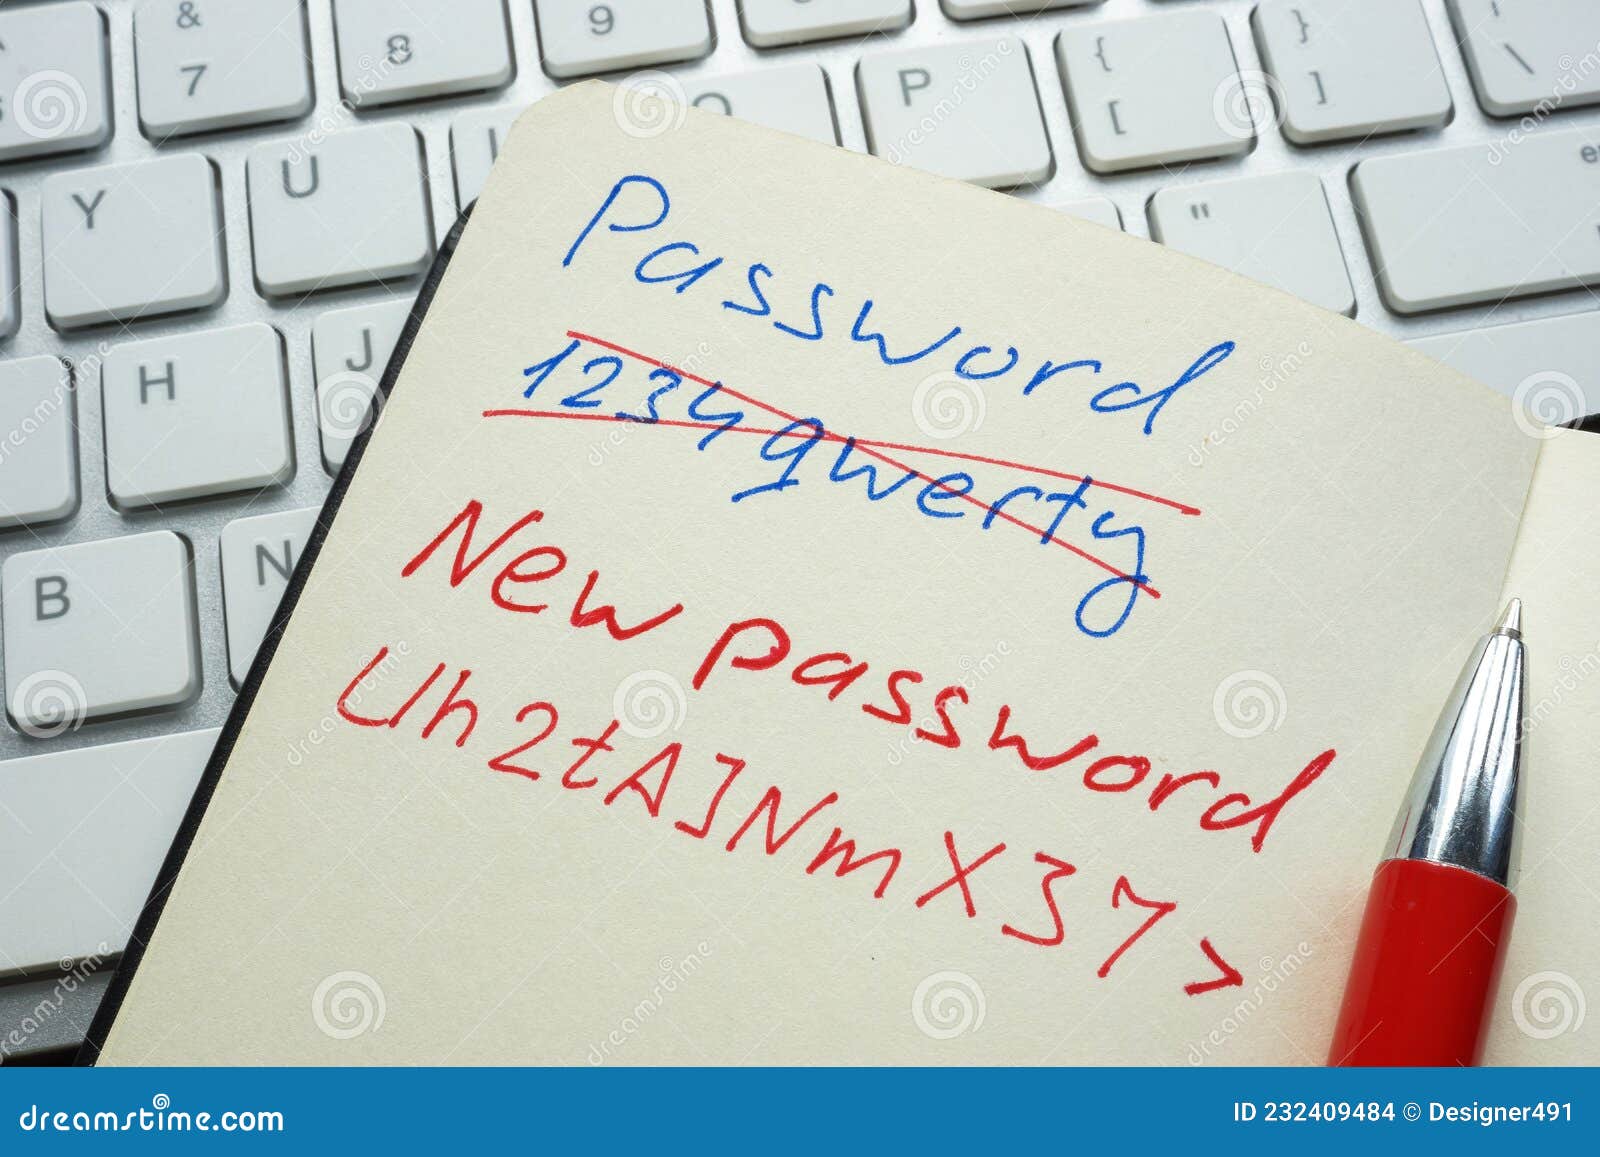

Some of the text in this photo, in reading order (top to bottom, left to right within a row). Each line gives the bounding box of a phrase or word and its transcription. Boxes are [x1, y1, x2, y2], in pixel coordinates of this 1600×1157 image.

[588, 7, 615, 36] 9
[386, 34, 413, 65] 8
[181, 64, 207, 97] 7
[897, 68, 932, 107] P
[281, 155, 320, 199] U
[71, 190, 107, 230] Y
[563, 176, 1235, 435] Password
[345, 328, 375, 372] J
[138, 361, 176, 405] H
[254, 539, 294, 587] N
[35, 575, 72, 621] B
[402, 500, 1336, 852] New password
